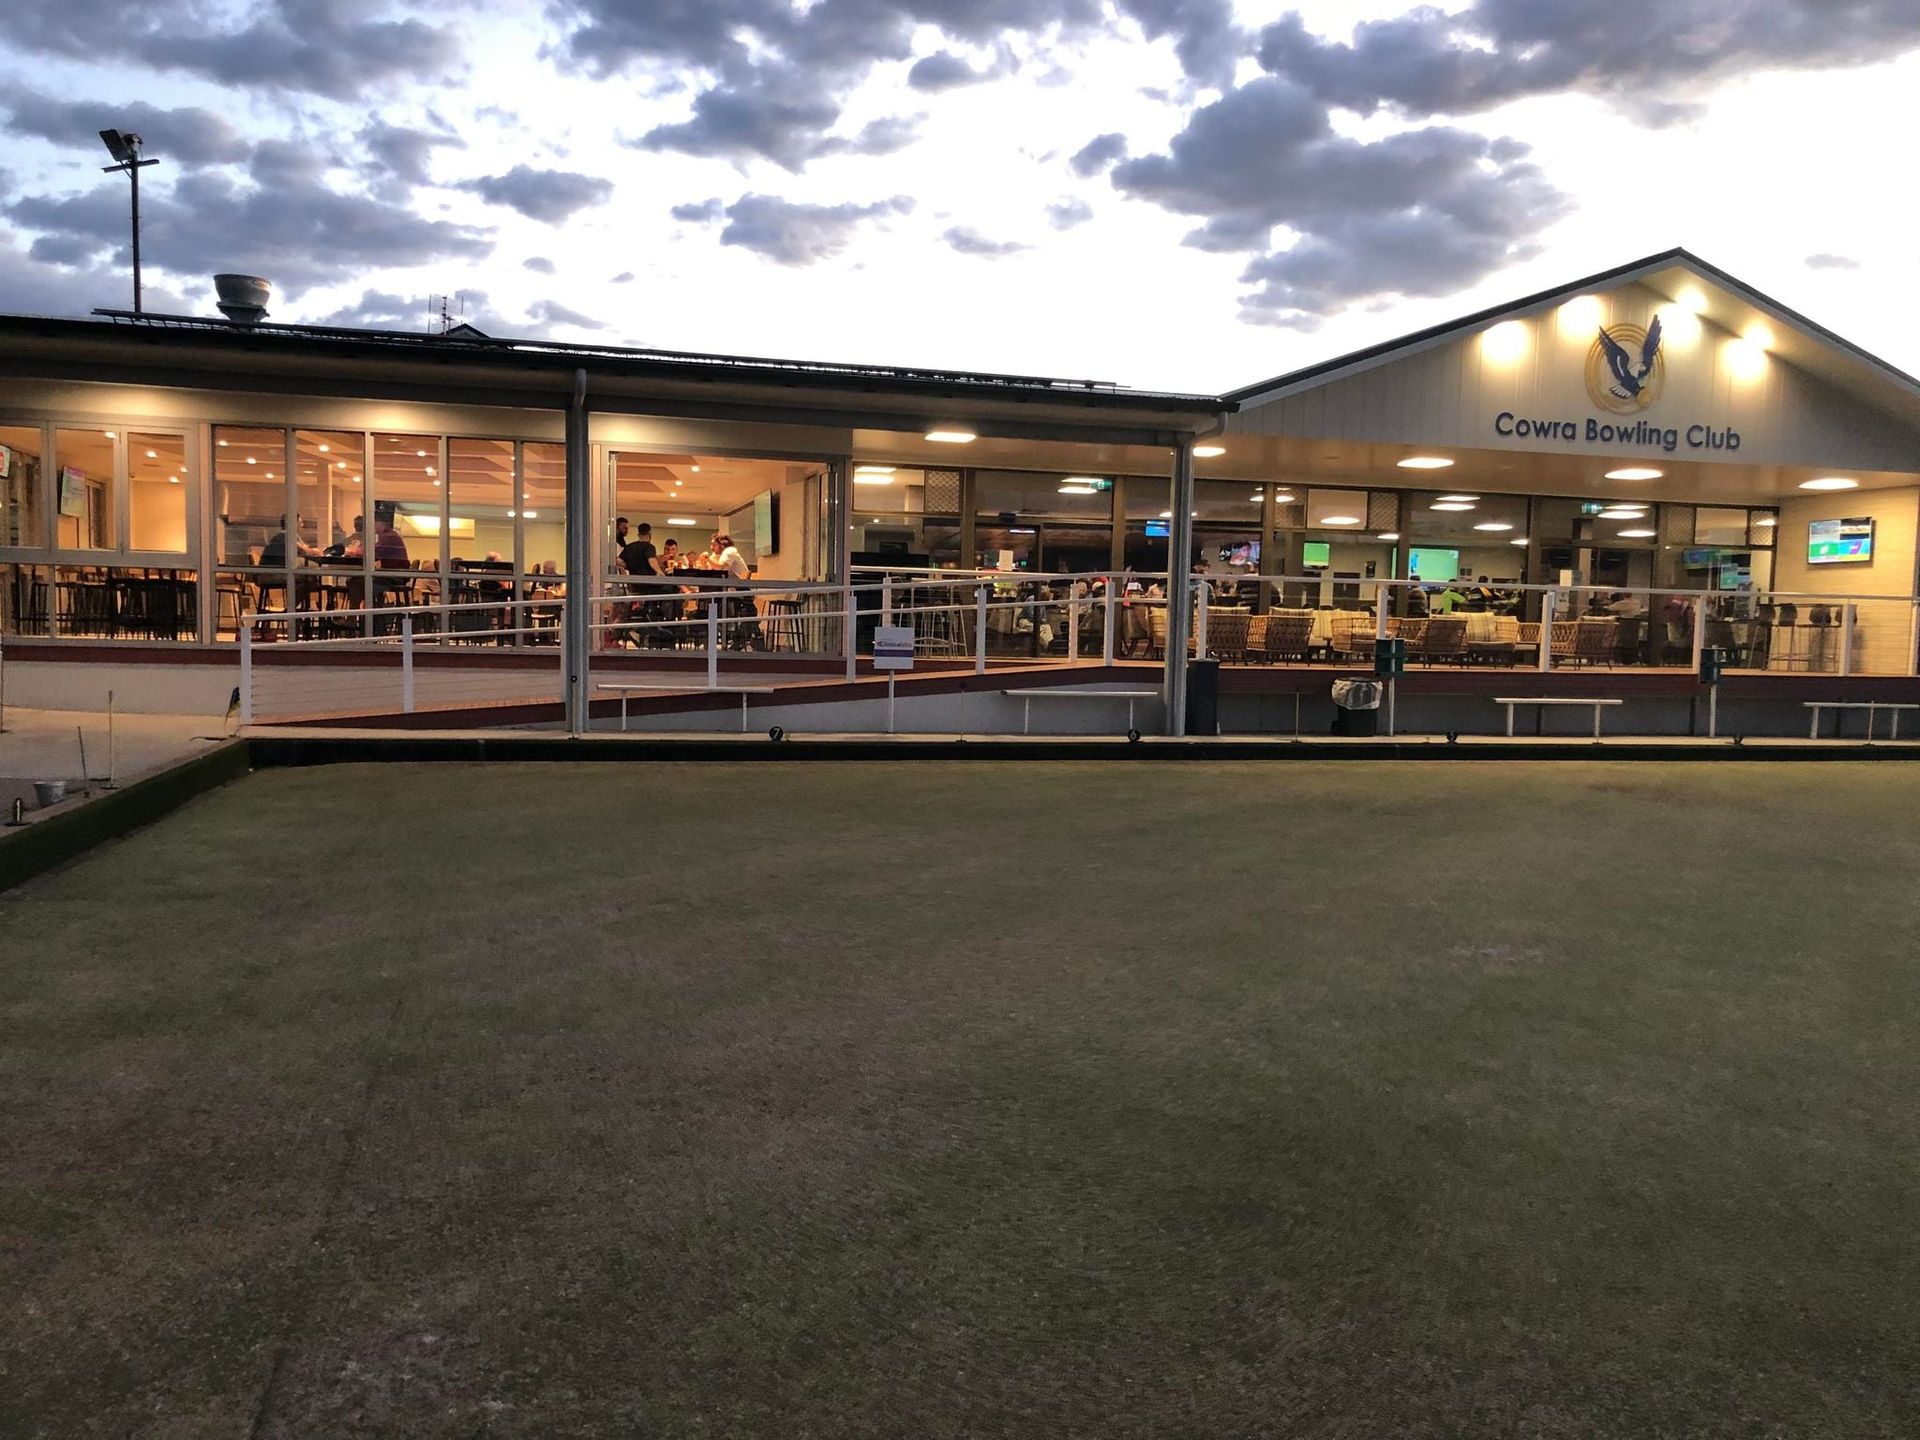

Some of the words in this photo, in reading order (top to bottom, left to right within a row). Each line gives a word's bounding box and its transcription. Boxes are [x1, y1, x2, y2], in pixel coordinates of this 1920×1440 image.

[1495, 412, 1576, 440] Cowra
[1585, 418, 1678, 450] Bowling
[1686, 424, 1741, 450] Club
